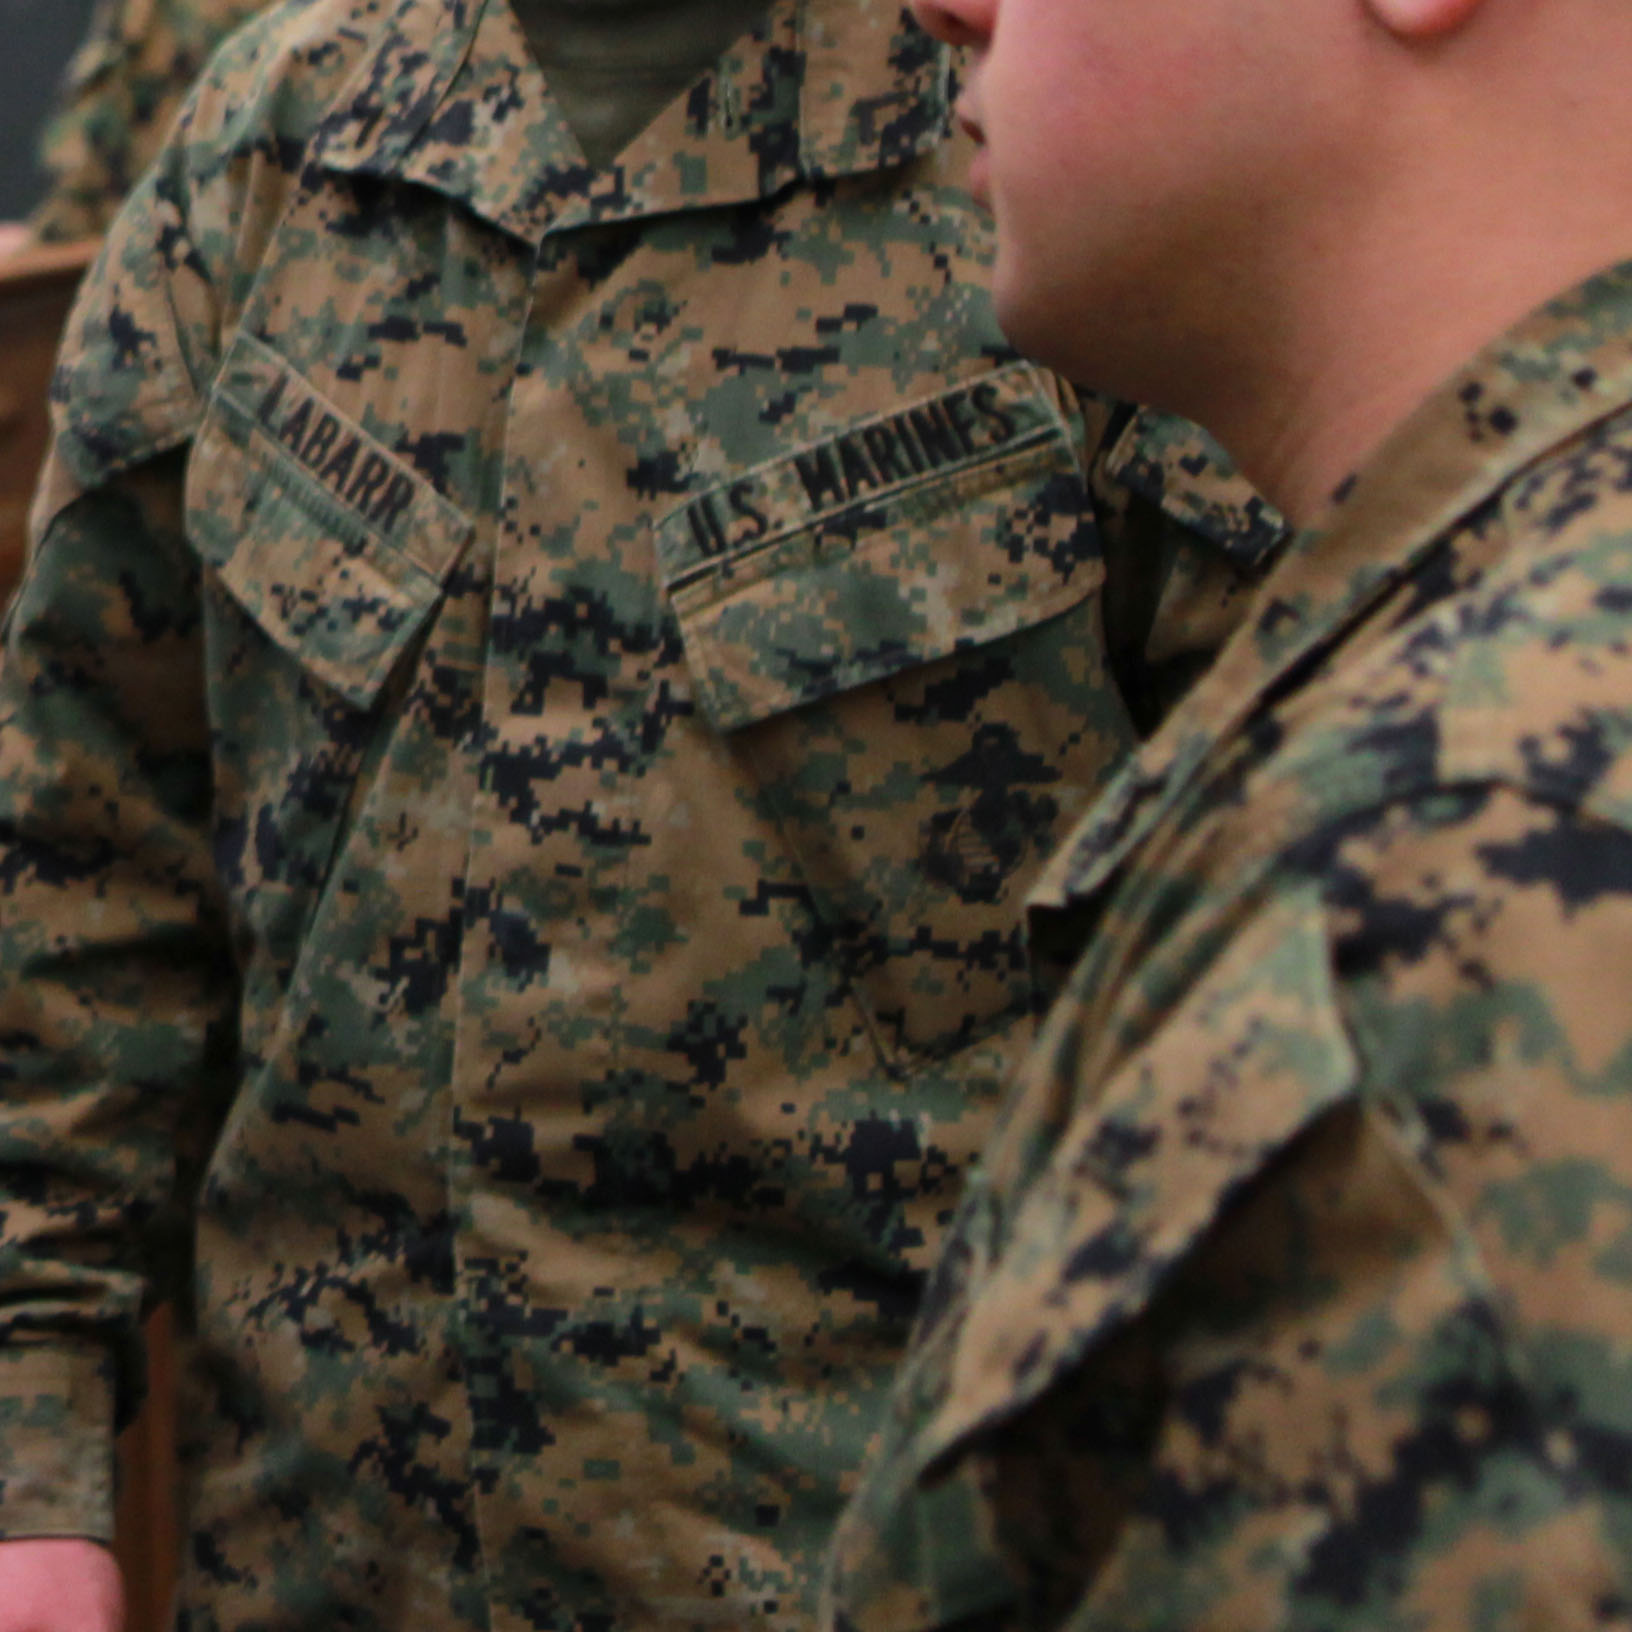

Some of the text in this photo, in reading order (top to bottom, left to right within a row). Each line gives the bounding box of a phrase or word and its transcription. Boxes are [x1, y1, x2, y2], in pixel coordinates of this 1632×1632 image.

[256, 369, 416, 534] LABARR
[686, 381, 1016, 558] U.S. MARINES
